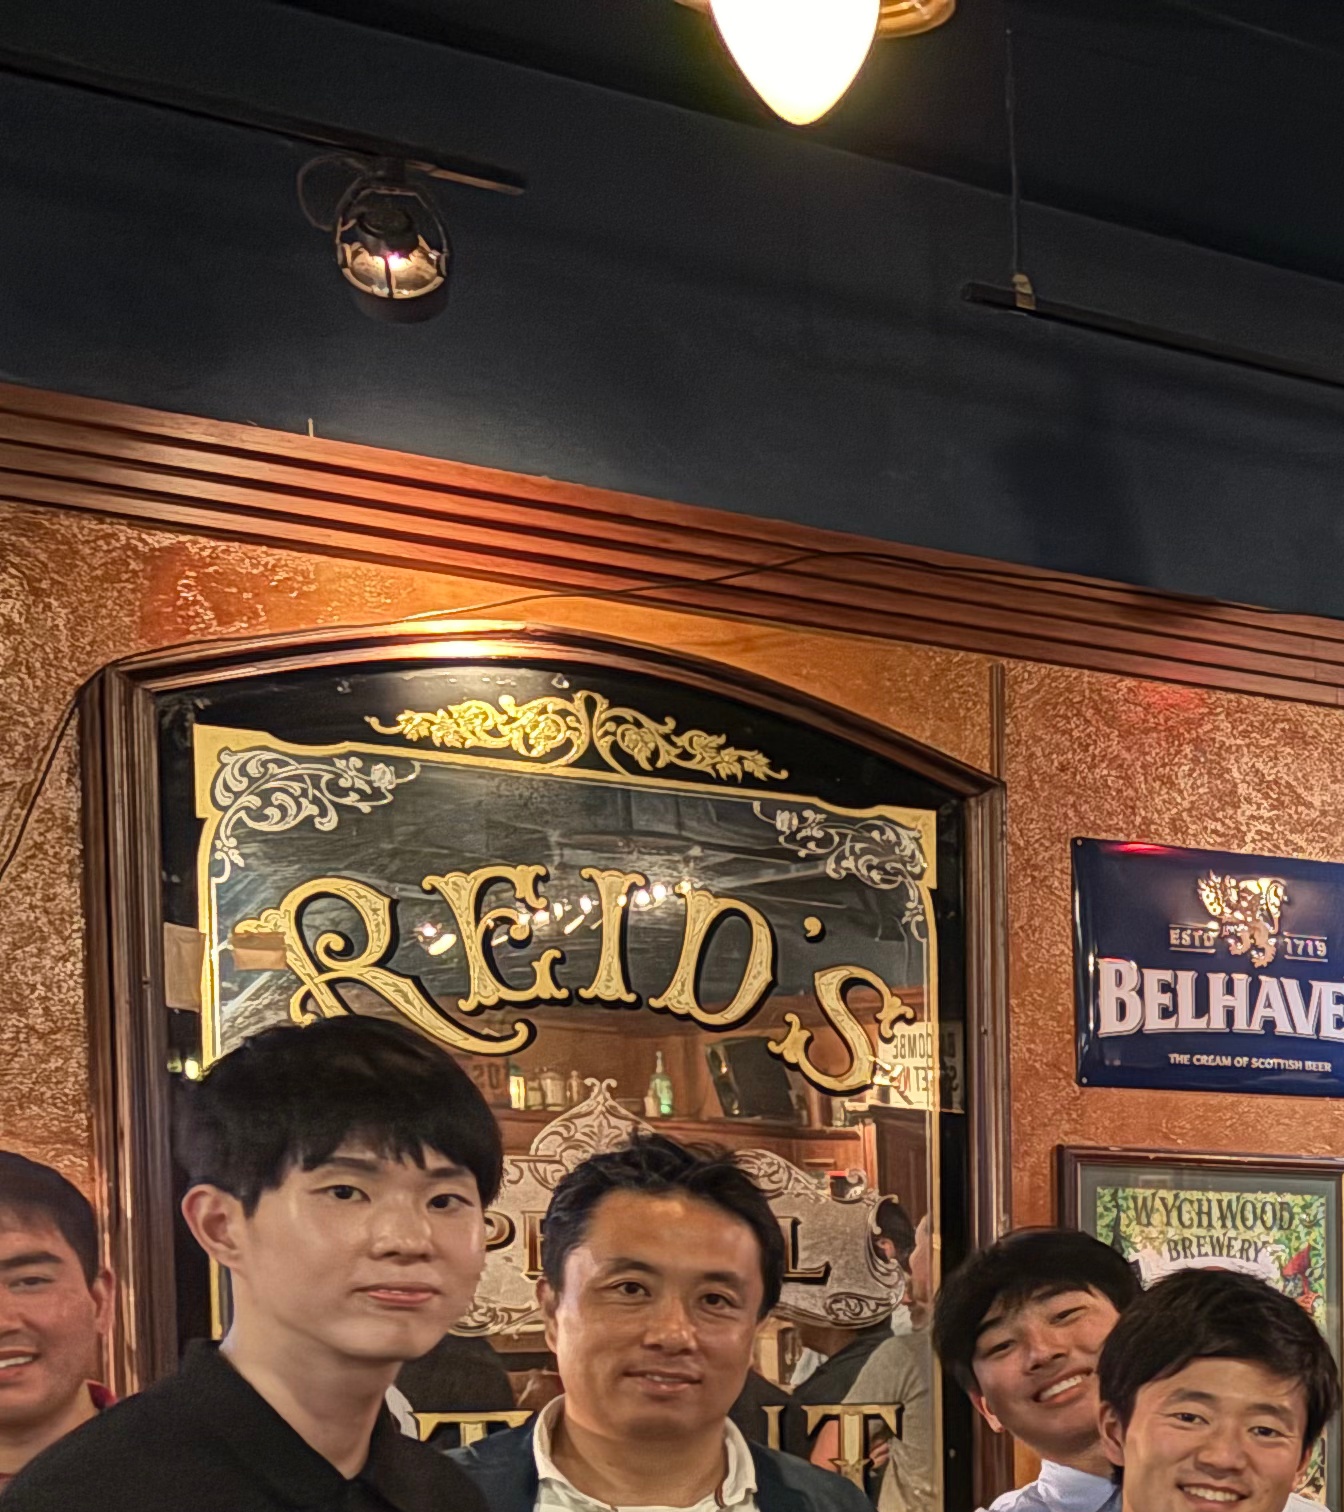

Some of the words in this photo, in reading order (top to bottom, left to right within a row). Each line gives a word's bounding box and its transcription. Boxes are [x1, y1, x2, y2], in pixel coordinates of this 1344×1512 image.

[1169, 929, 1215, 947] ESTD
[233, 863, 915, 1096] REID'S
[1168, 1053, 1190, 1065] THE
[1193, 1054, 1232, 1067] CREAM
[1234, 1057, 1249, 1068] OF
[1251, 1057, 1303, 1070] SCOTTISH
[1304, 1061, 1332, 1072] BEER
[1132, 1193, 1295, 1231] WYCHWOOD
[1167, 1230, 1269, 1263] BREWERY
